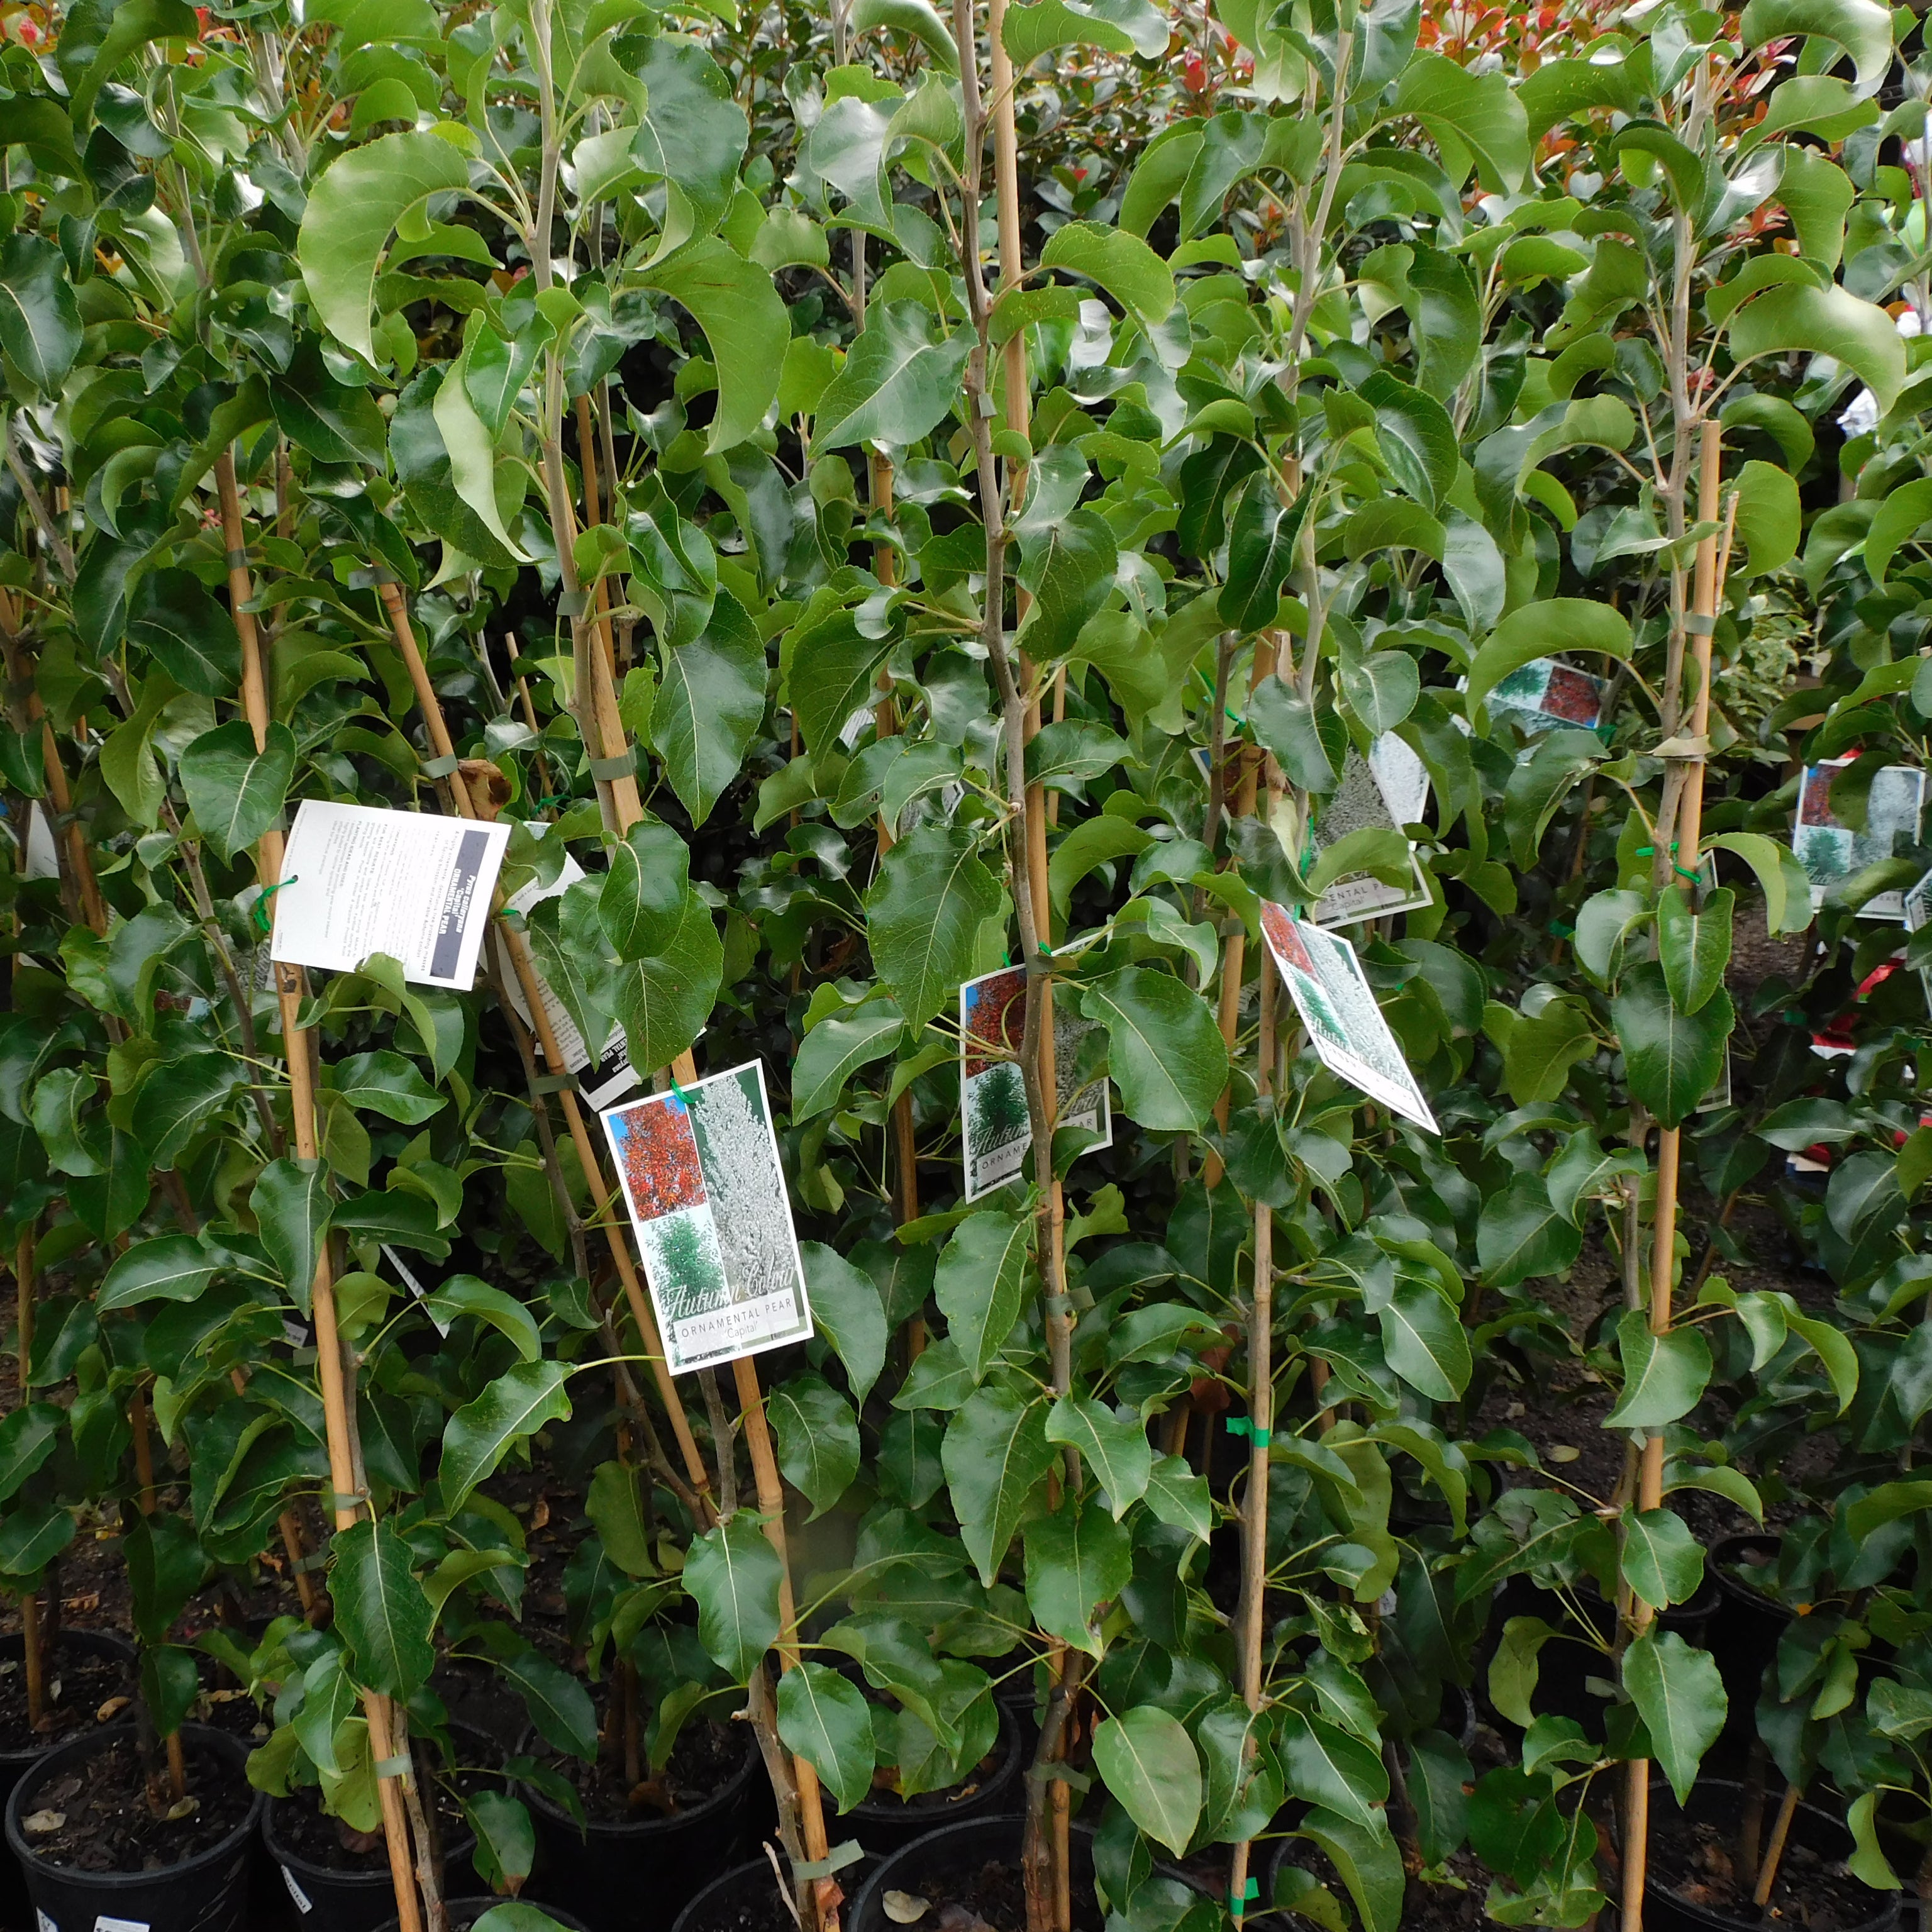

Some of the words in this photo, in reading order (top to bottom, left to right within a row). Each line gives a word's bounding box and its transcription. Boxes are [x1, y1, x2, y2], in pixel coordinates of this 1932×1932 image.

[443, 867, 462, 914] ORNAMENTAL
[438, 914, 449, 935] PEAR
[982, 1143, 1028, 1170] ORNAME
[665, 1282, 741, 1320] Autumn
[742, 1255, 797, 1297] Colour
[681, 1309, 760, 1338] ORNAMENTAL
[765, 1297, 792, 1314] PEAR
